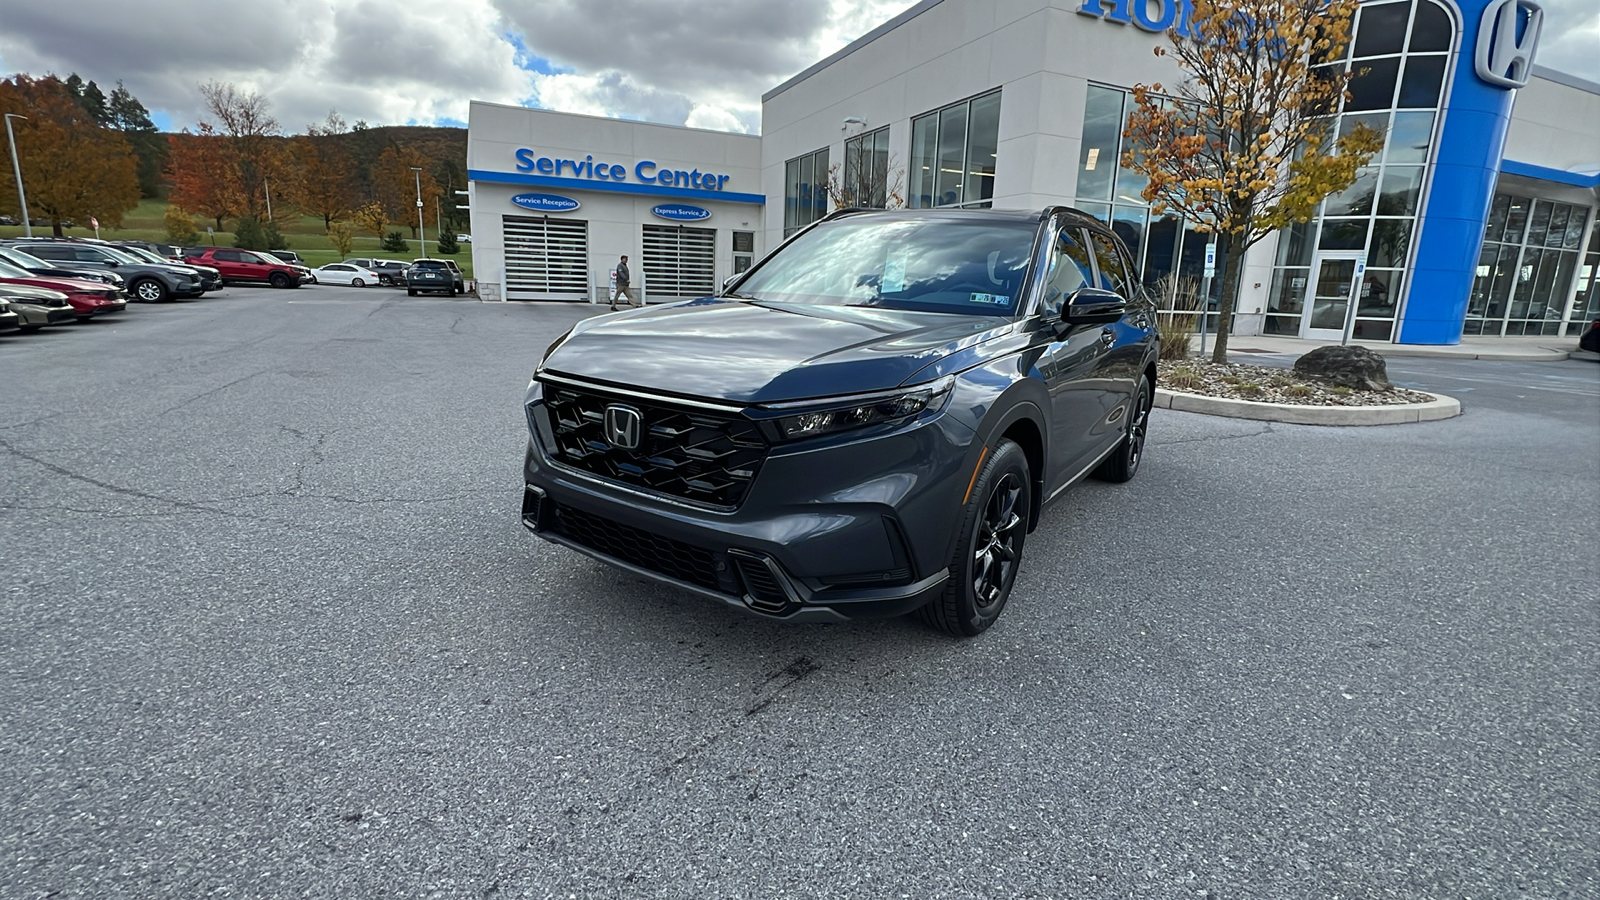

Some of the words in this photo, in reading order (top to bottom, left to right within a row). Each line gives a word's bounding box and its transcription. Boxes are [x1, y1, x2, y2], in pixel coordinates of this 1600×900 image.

[515, 148, 626, 181] Service
[635, 161, 729, 190] Center
[515, 196, 541, 204] Service
[542, 198, 576, 207] Reception
[655, 207, 678, 215] Express
[678, 208, 699, 216] Service
